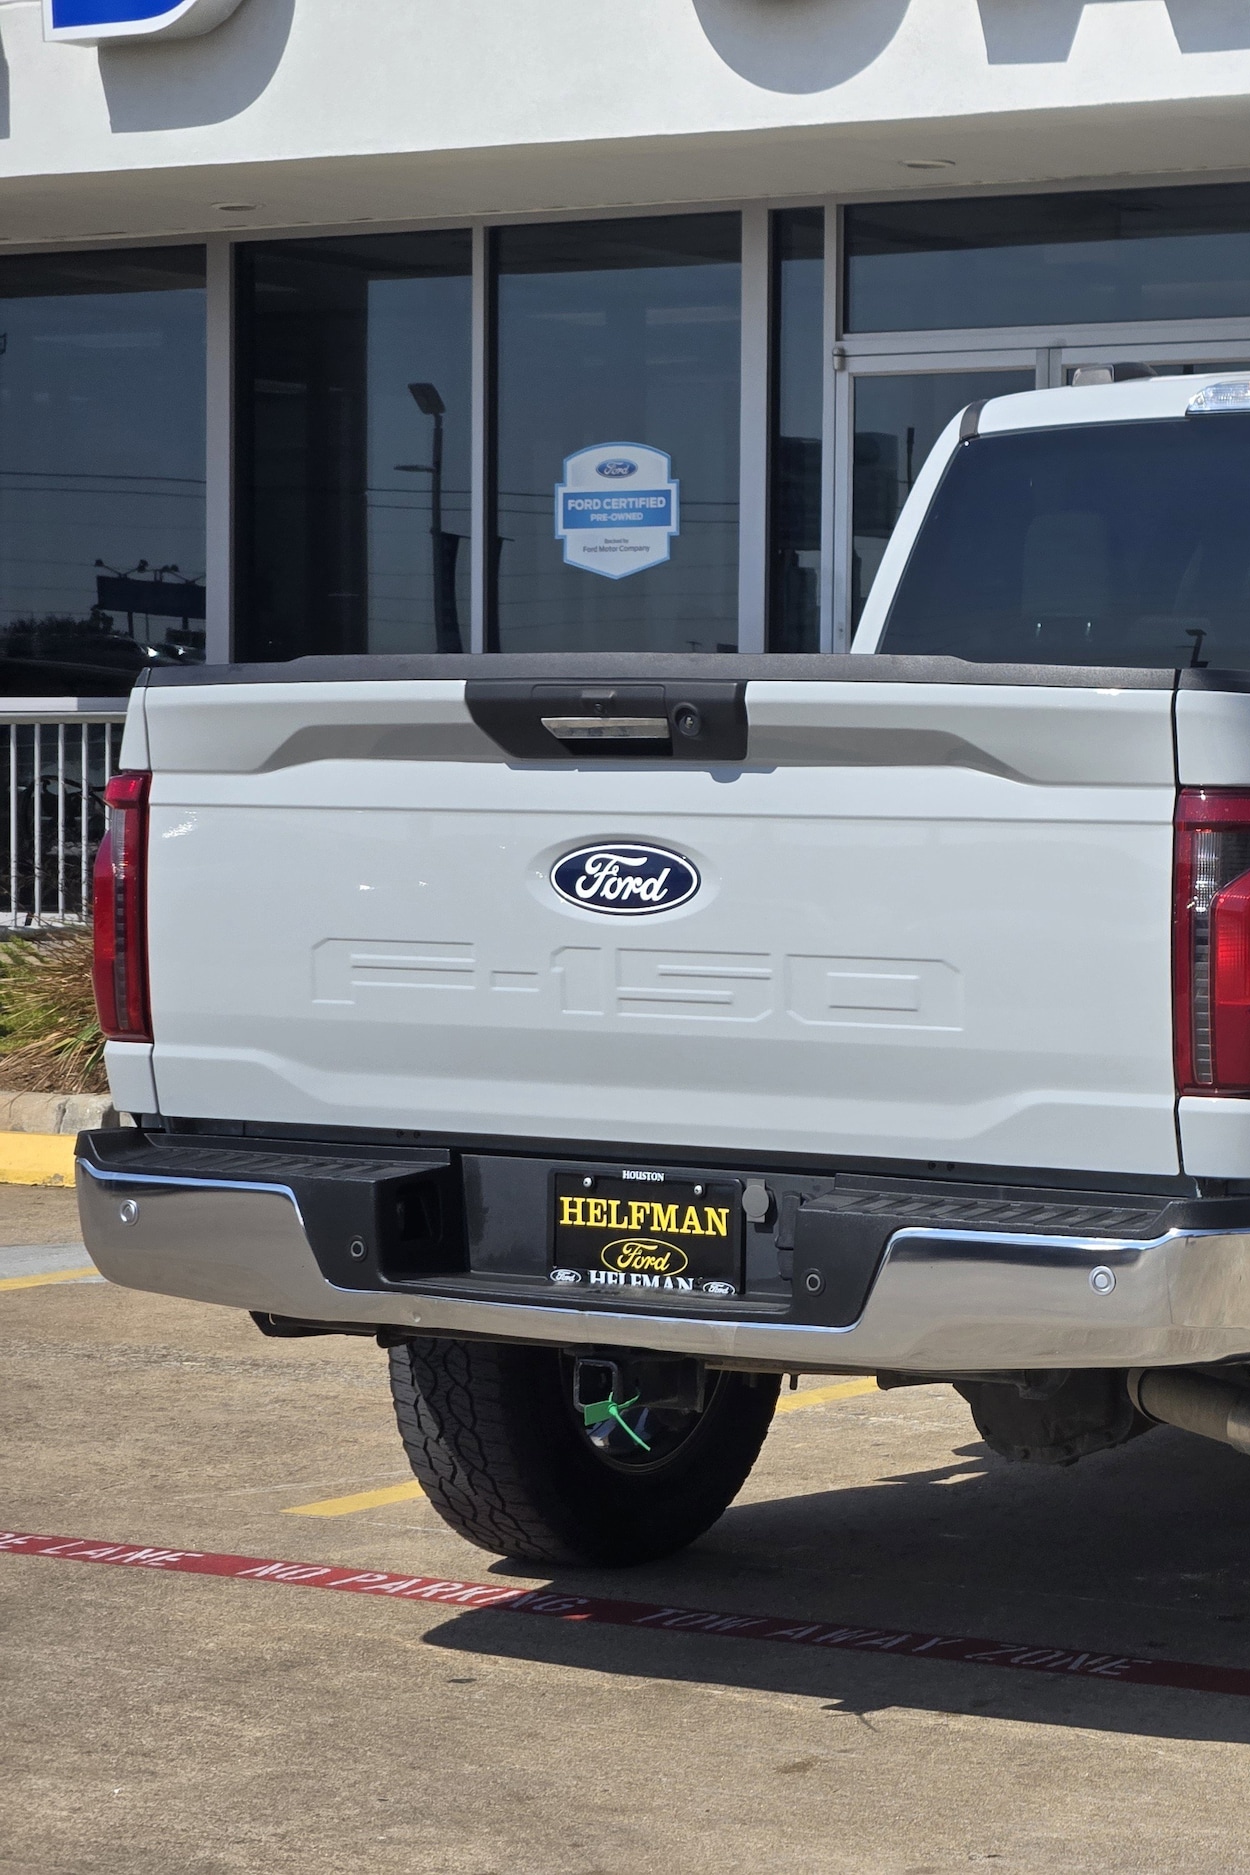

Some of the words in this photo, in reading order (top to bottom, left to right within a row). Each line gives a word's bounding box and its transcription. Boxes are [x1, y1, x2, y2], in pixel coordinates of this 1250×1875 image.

[603, 461, 630, 475] Ford
[567, 498, 601, 511] FORD
[603, 496, 666, 510] CERTIFIED
[590, 512, 644, 522] PRE-OWNED
[583, 545, 598, 553] Ford
[599, 545, 618, 553] Motor
[618, 544, 650, 553] Company
[575, 853, 672, 901] Ford
[311, 937, 965, 1031] F-150
[622, 1169, 665, 1182] HOUSTON
[559, 1196, 730, 1237] HELFMAN
[616, 1242, 671, 1271] Ford
[556, 1271, 577, 1282] Ford
[588, 1270, 694, 1291] HELFMAN
[708, 1284, 729, 1295] Ford
[39, 1540, 204, 1567] LANE
[235, 1562, 332, 1580] NO
[328, 1572, 588, 1612] PARKING
[632, 1608, 768, 1632] TOW
[764, 1624, 965, 1652] AWAY
[964, 1643, 1153, 1676] ZONE
